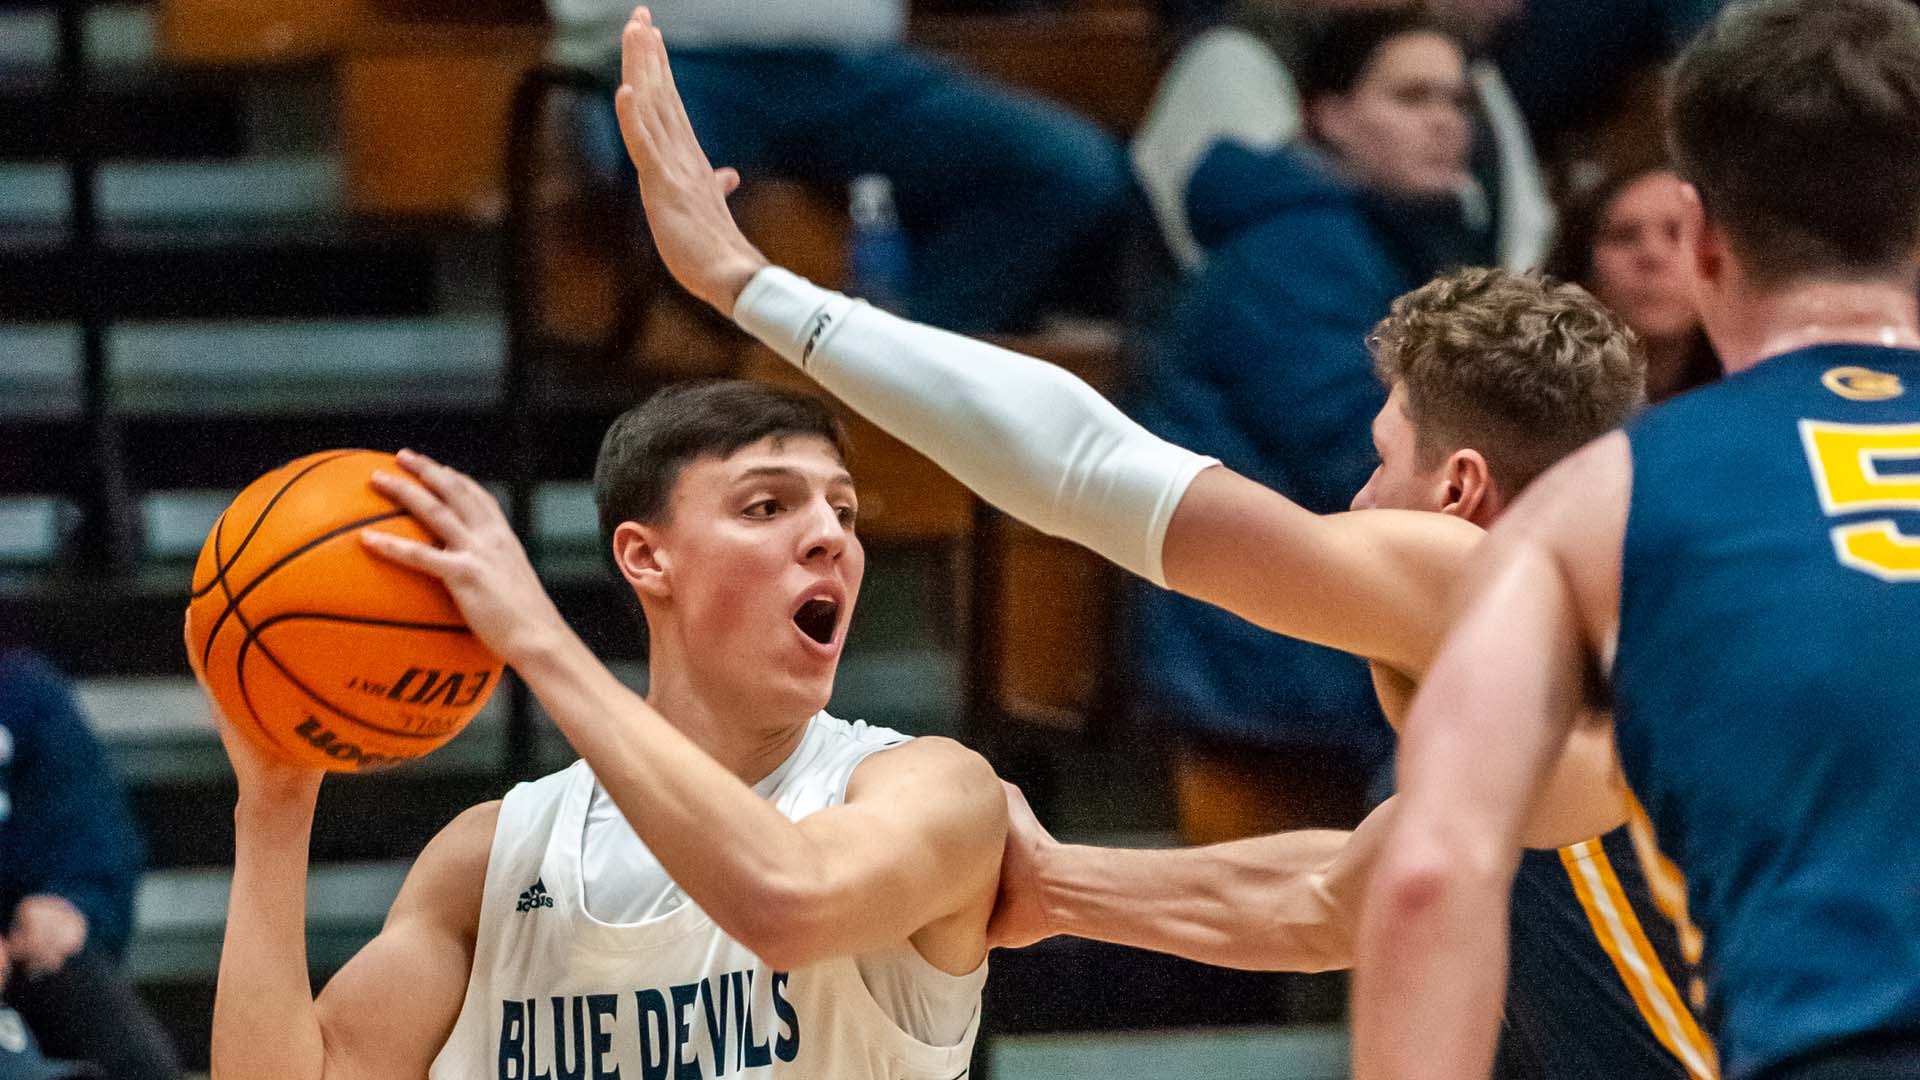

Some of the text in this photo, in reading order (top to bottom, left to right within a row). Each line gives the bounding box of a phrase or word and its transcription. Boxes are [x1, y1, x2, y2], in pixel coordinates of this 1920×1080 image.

[387, 667, 490, 707] EVO
[499, 968, 800, 1080] BLUE DEVILS
